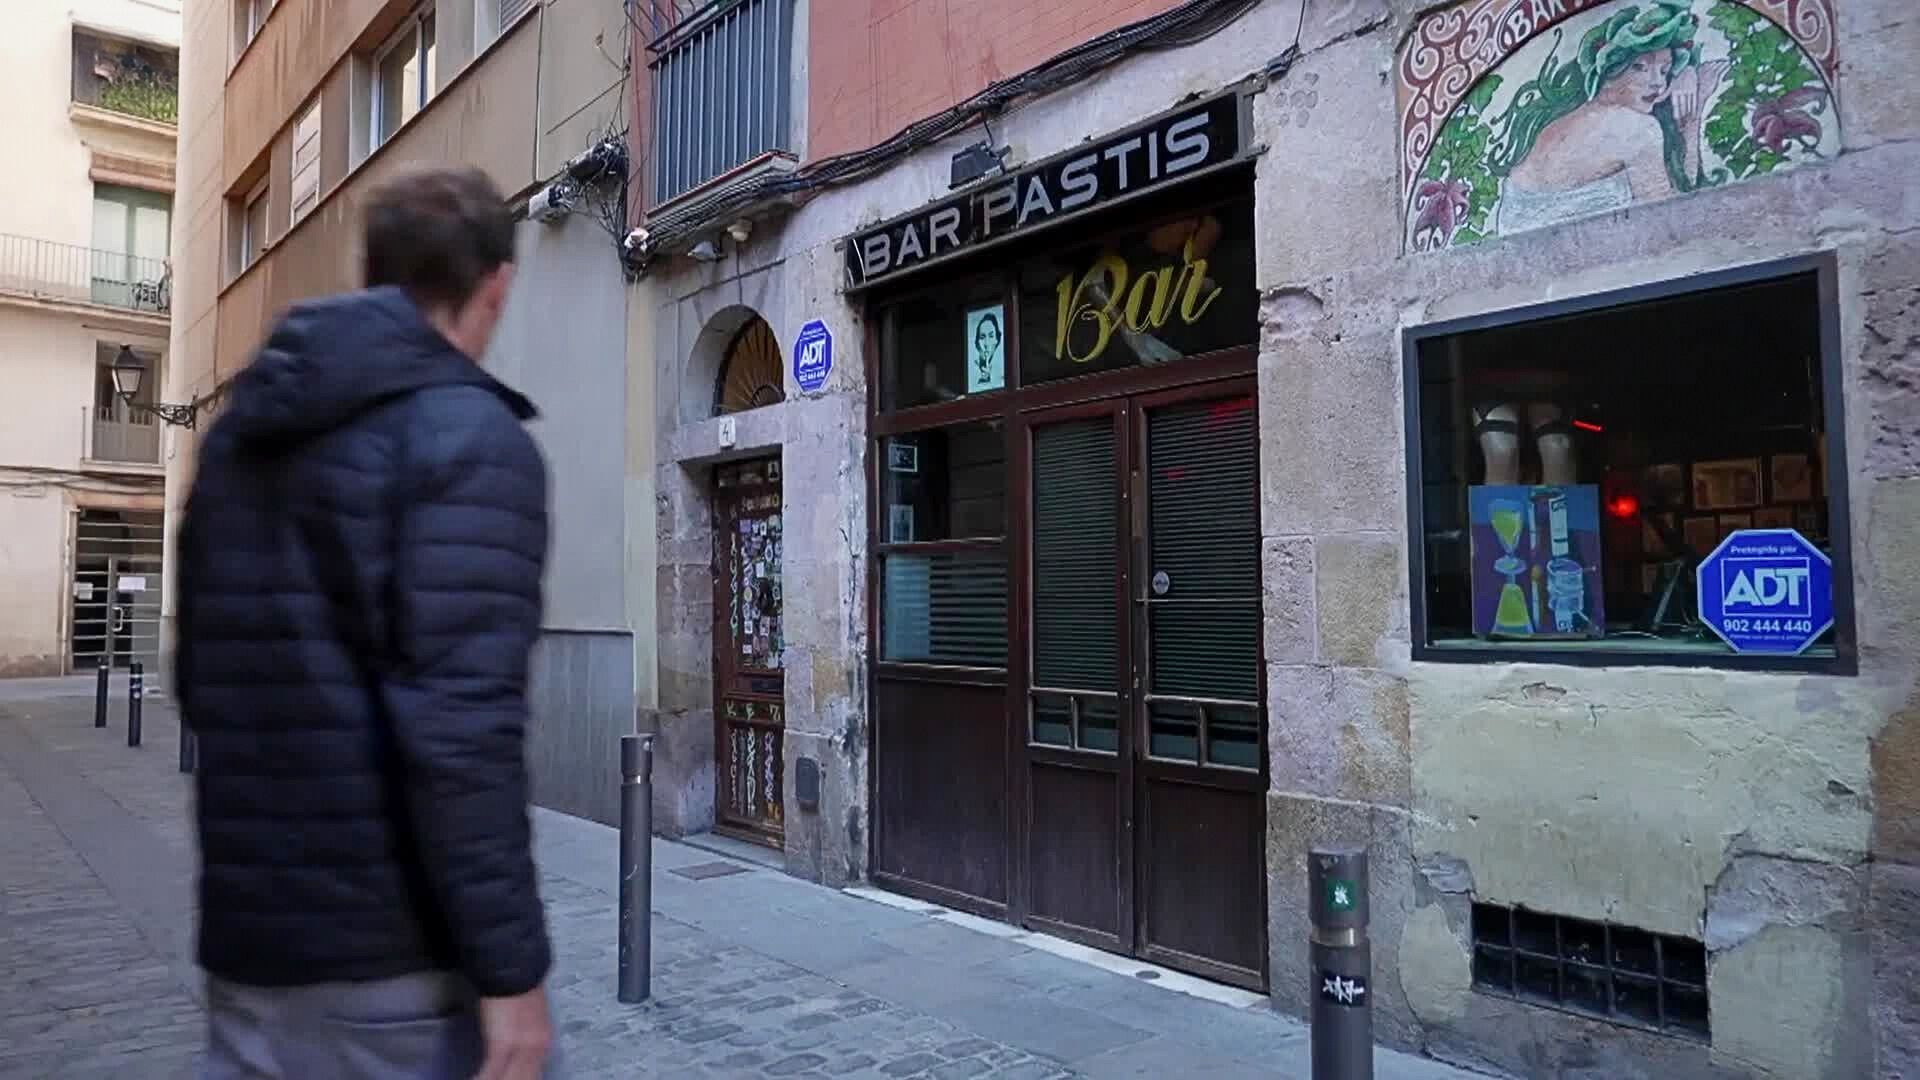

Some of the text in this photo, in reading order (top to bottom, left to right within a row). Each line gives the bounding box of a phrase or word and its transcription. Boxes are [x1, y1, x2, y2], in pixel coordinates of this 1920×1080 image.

[864, 111, 1211, 277] BAR PASTIS
[1055, 239, 1222, 363] Bar
[800, 339, 826, 368] ADT
[1724, 567, 1809, 606] ADT
[1723, 619, 1812, 633] 902 444 440
